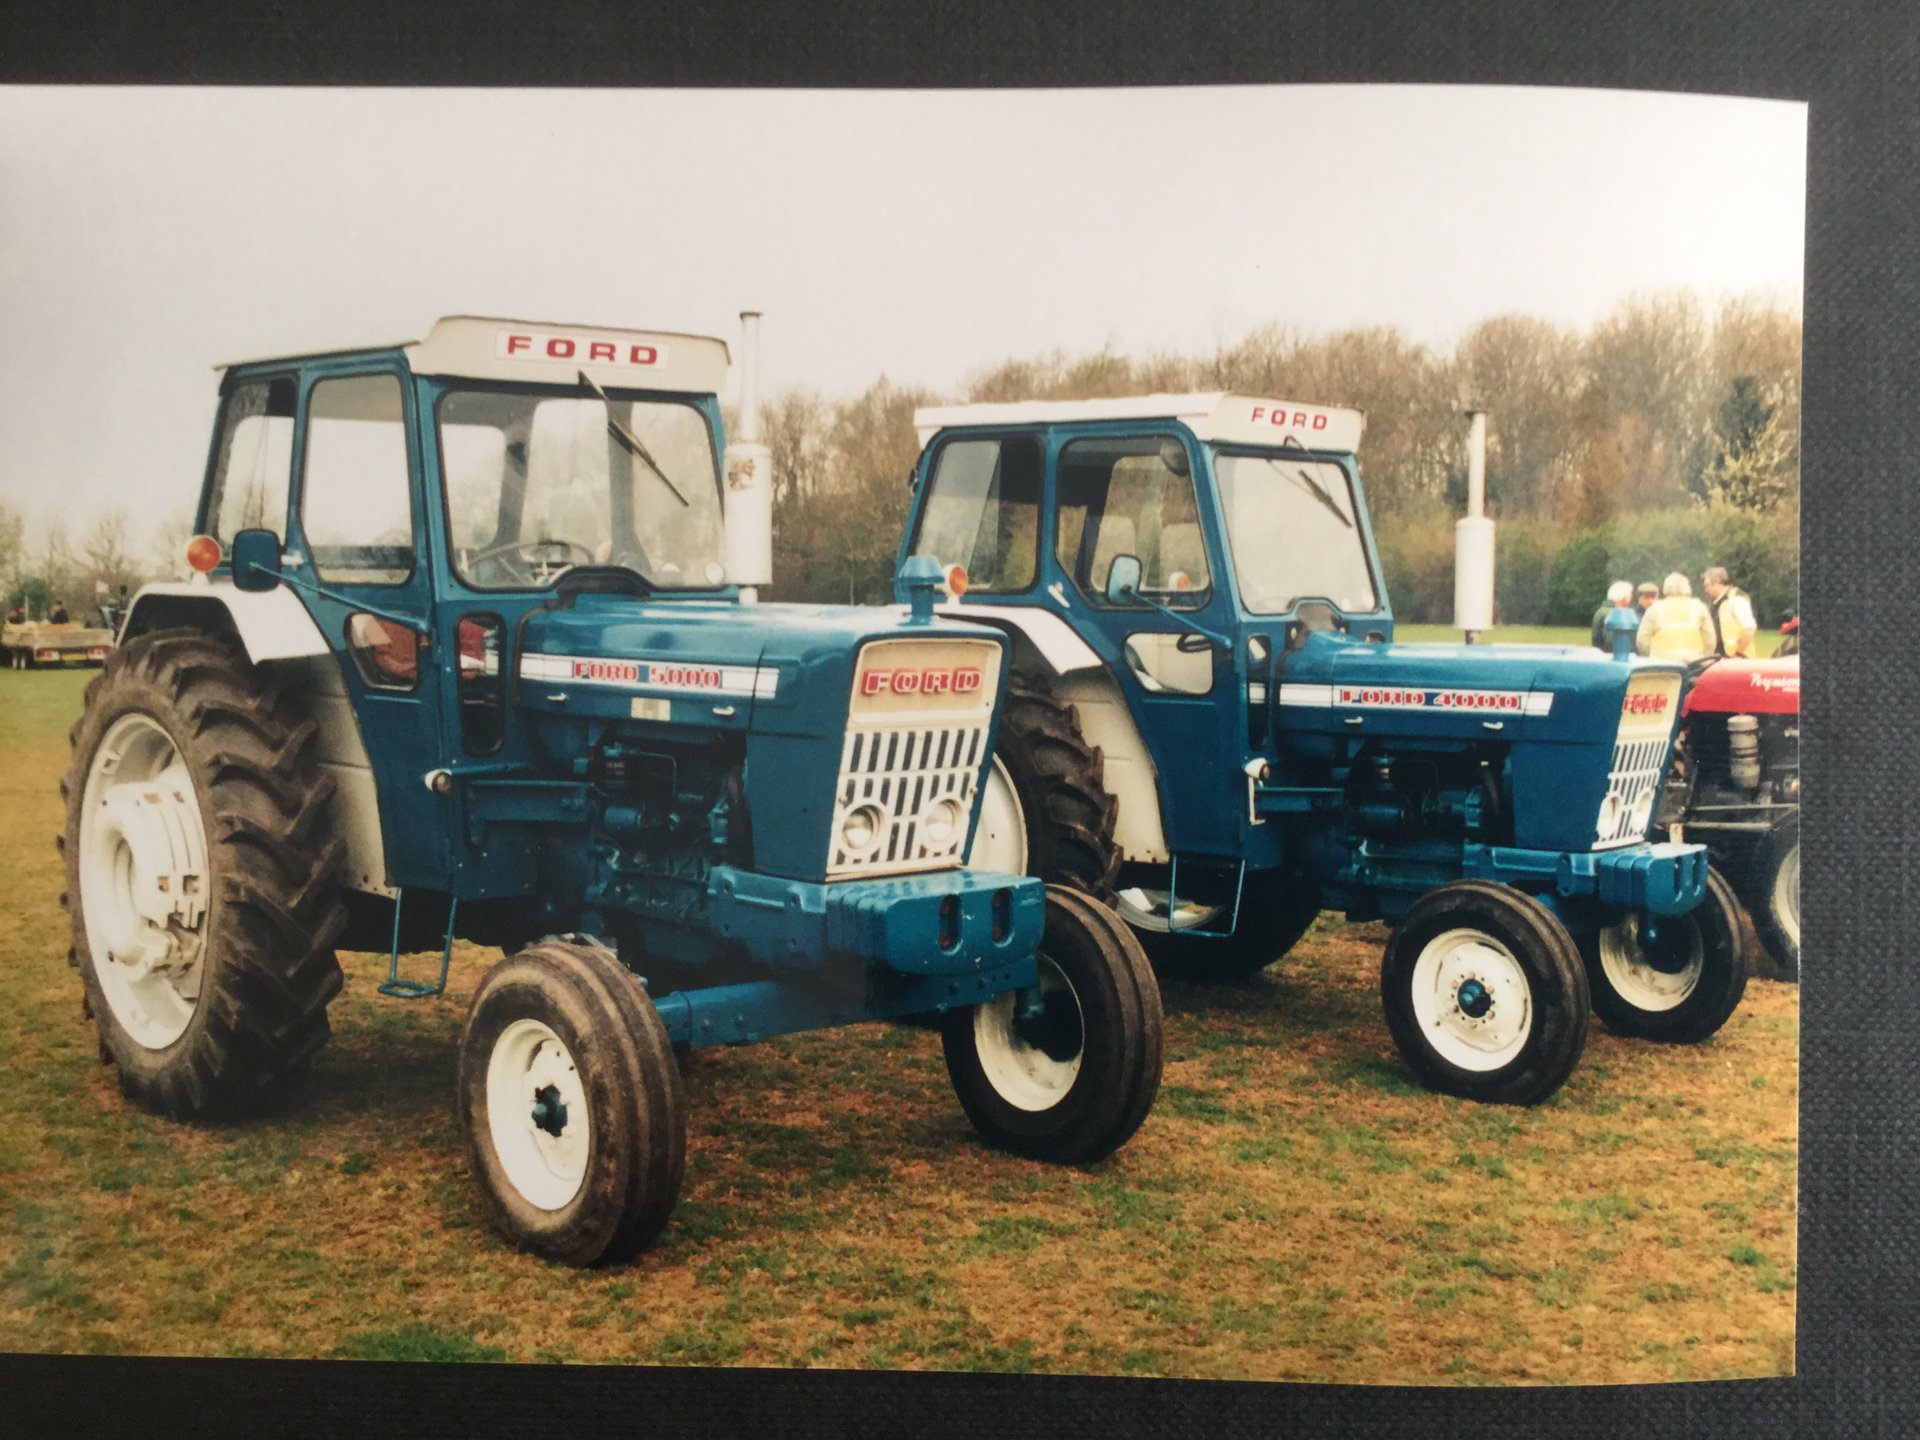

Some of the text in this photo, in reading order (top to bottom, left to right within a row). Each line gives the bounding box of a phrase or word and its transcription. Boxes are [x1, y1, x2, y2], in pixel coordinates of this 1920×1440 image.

[507, 335, 658, 366] FORD
[1251, 406, 1328, 431] FORD
[573, 660, 721, 688] FORD 5000
[861, 667, 982, 695] FORD
[1342, 689, 1519, 709] FORD 4000
